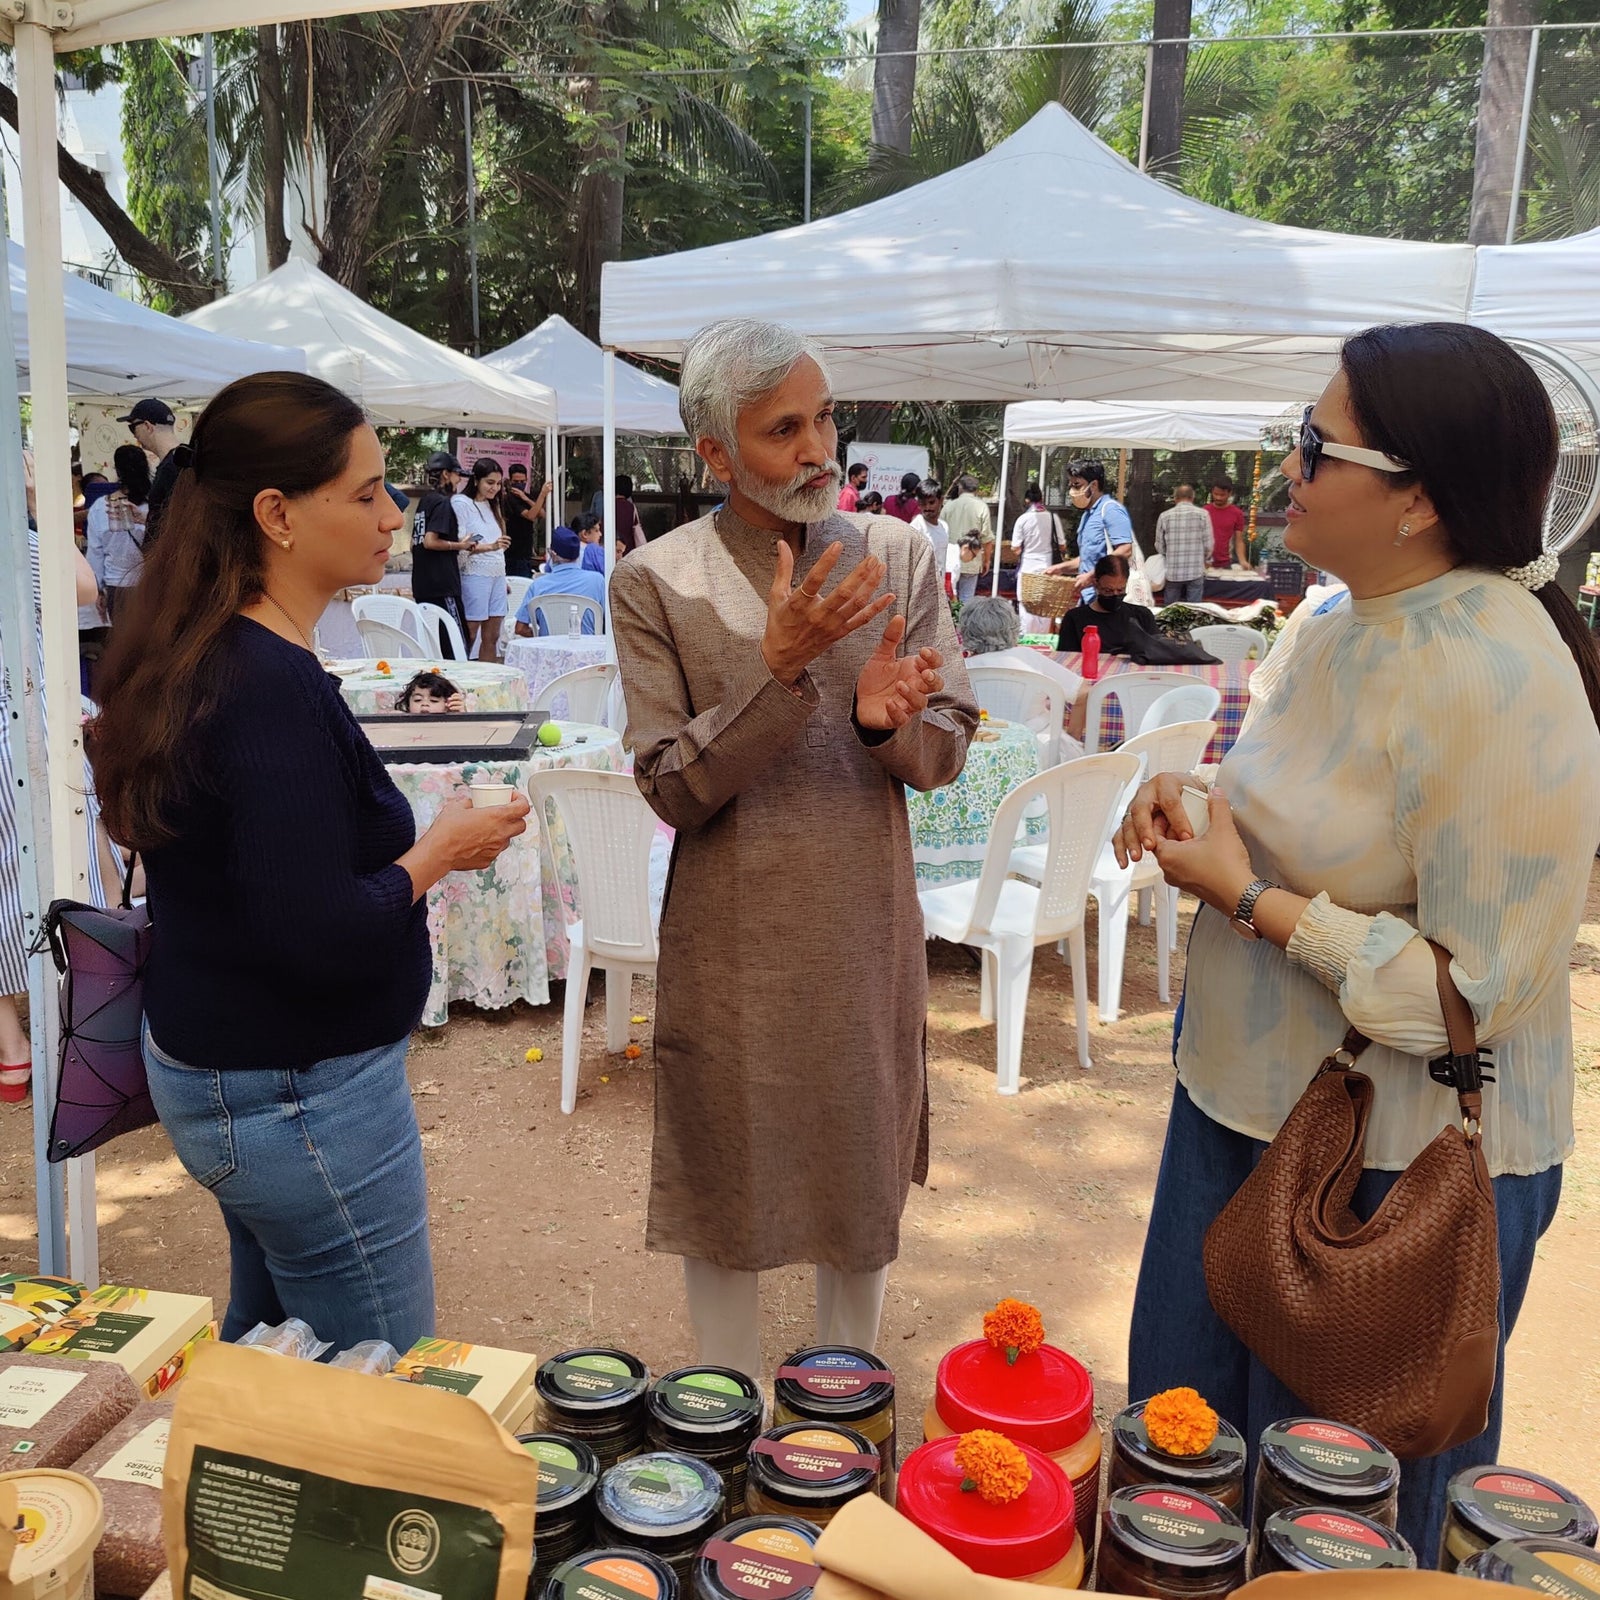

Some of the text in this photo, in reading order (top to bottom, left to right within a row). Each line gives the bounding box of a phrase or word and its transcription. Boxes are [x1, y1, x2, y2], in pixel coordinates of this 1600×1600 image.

[872, 473, 903, 483] FARM
[872, 483, 900, 491] MARK
[566, 1374, 614, 1388] BROTHERS
[575, 1382, 597, 1390] TWO
[677, 1394, 727, 1408] BROTHERS
[687, 1402, 710, 1410] TWO
[1300, 1446, 1359, 1463] BROTHERS
[785, 1455, 842, 1468] BROTHERS
[1316, 1456, 1344, 1466] TWO
[125, 1462, 162, 1474] OTHERS
[203, 1461, 247, 1478] FARMERS
[248, 1471, 262, 1481] BY
[798, 1464, 824, 1472] TWO
[132, 1471, 153, 1479] TWO
[640, 1499, 664, 1509] TWO
[1494, 1503, 1559, 1519] BROTHERS
[1513, 1513, 1544, 1523] TWO
[1142, 1515, 1205, 1534] BROTHERS
[1158, 1526, 1186, 1536] TWO
[757, 1538, 799, 1552] CULTURED
[770, 1535, 792, 1544] GHEE
[1306, 1538, 1371, 1560] BROTHERS
[1322, 1549, 1352, 1561] TWO
[731, 1562, 792, 1584] BROTHERS
[742, 1576, 770, 1588] TWO
